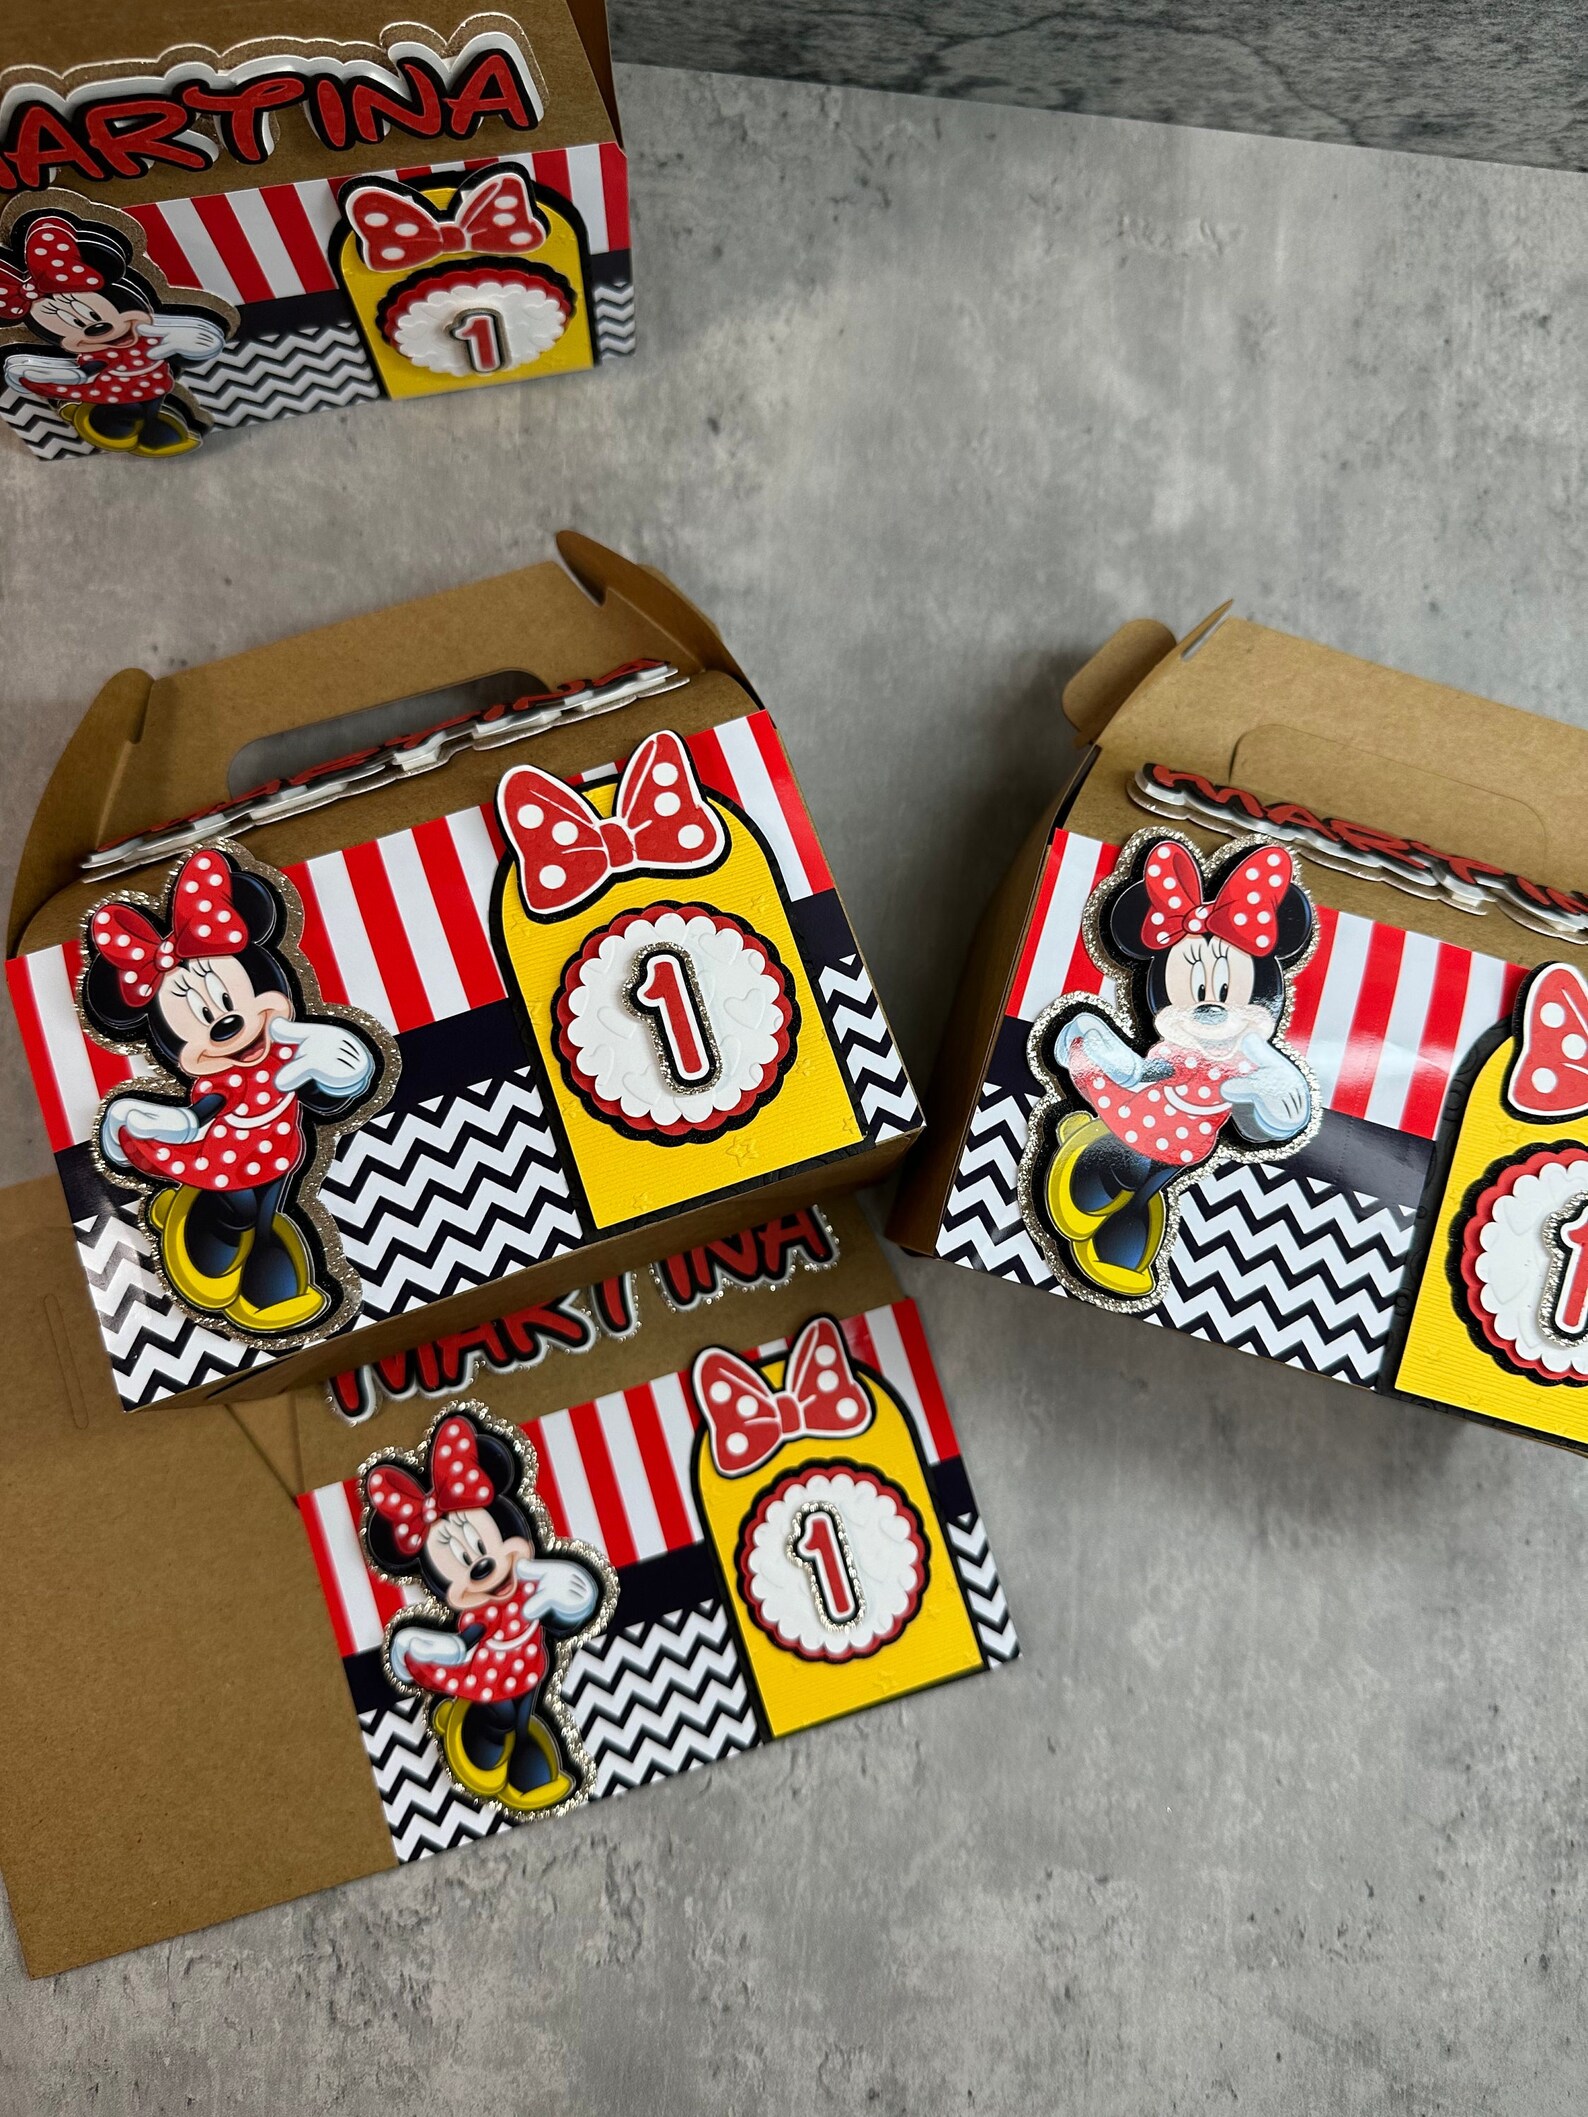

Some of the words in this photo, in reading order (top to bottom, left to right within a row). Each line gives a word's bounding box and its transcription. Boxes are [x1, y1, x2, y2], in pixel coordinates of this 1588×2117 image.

[0, 49, 538, 191] ARTINA
[454, 314, 501, 374] 1
[636, 954, 710, 1082] 1
[797, 1510, 856, 1620] 1
